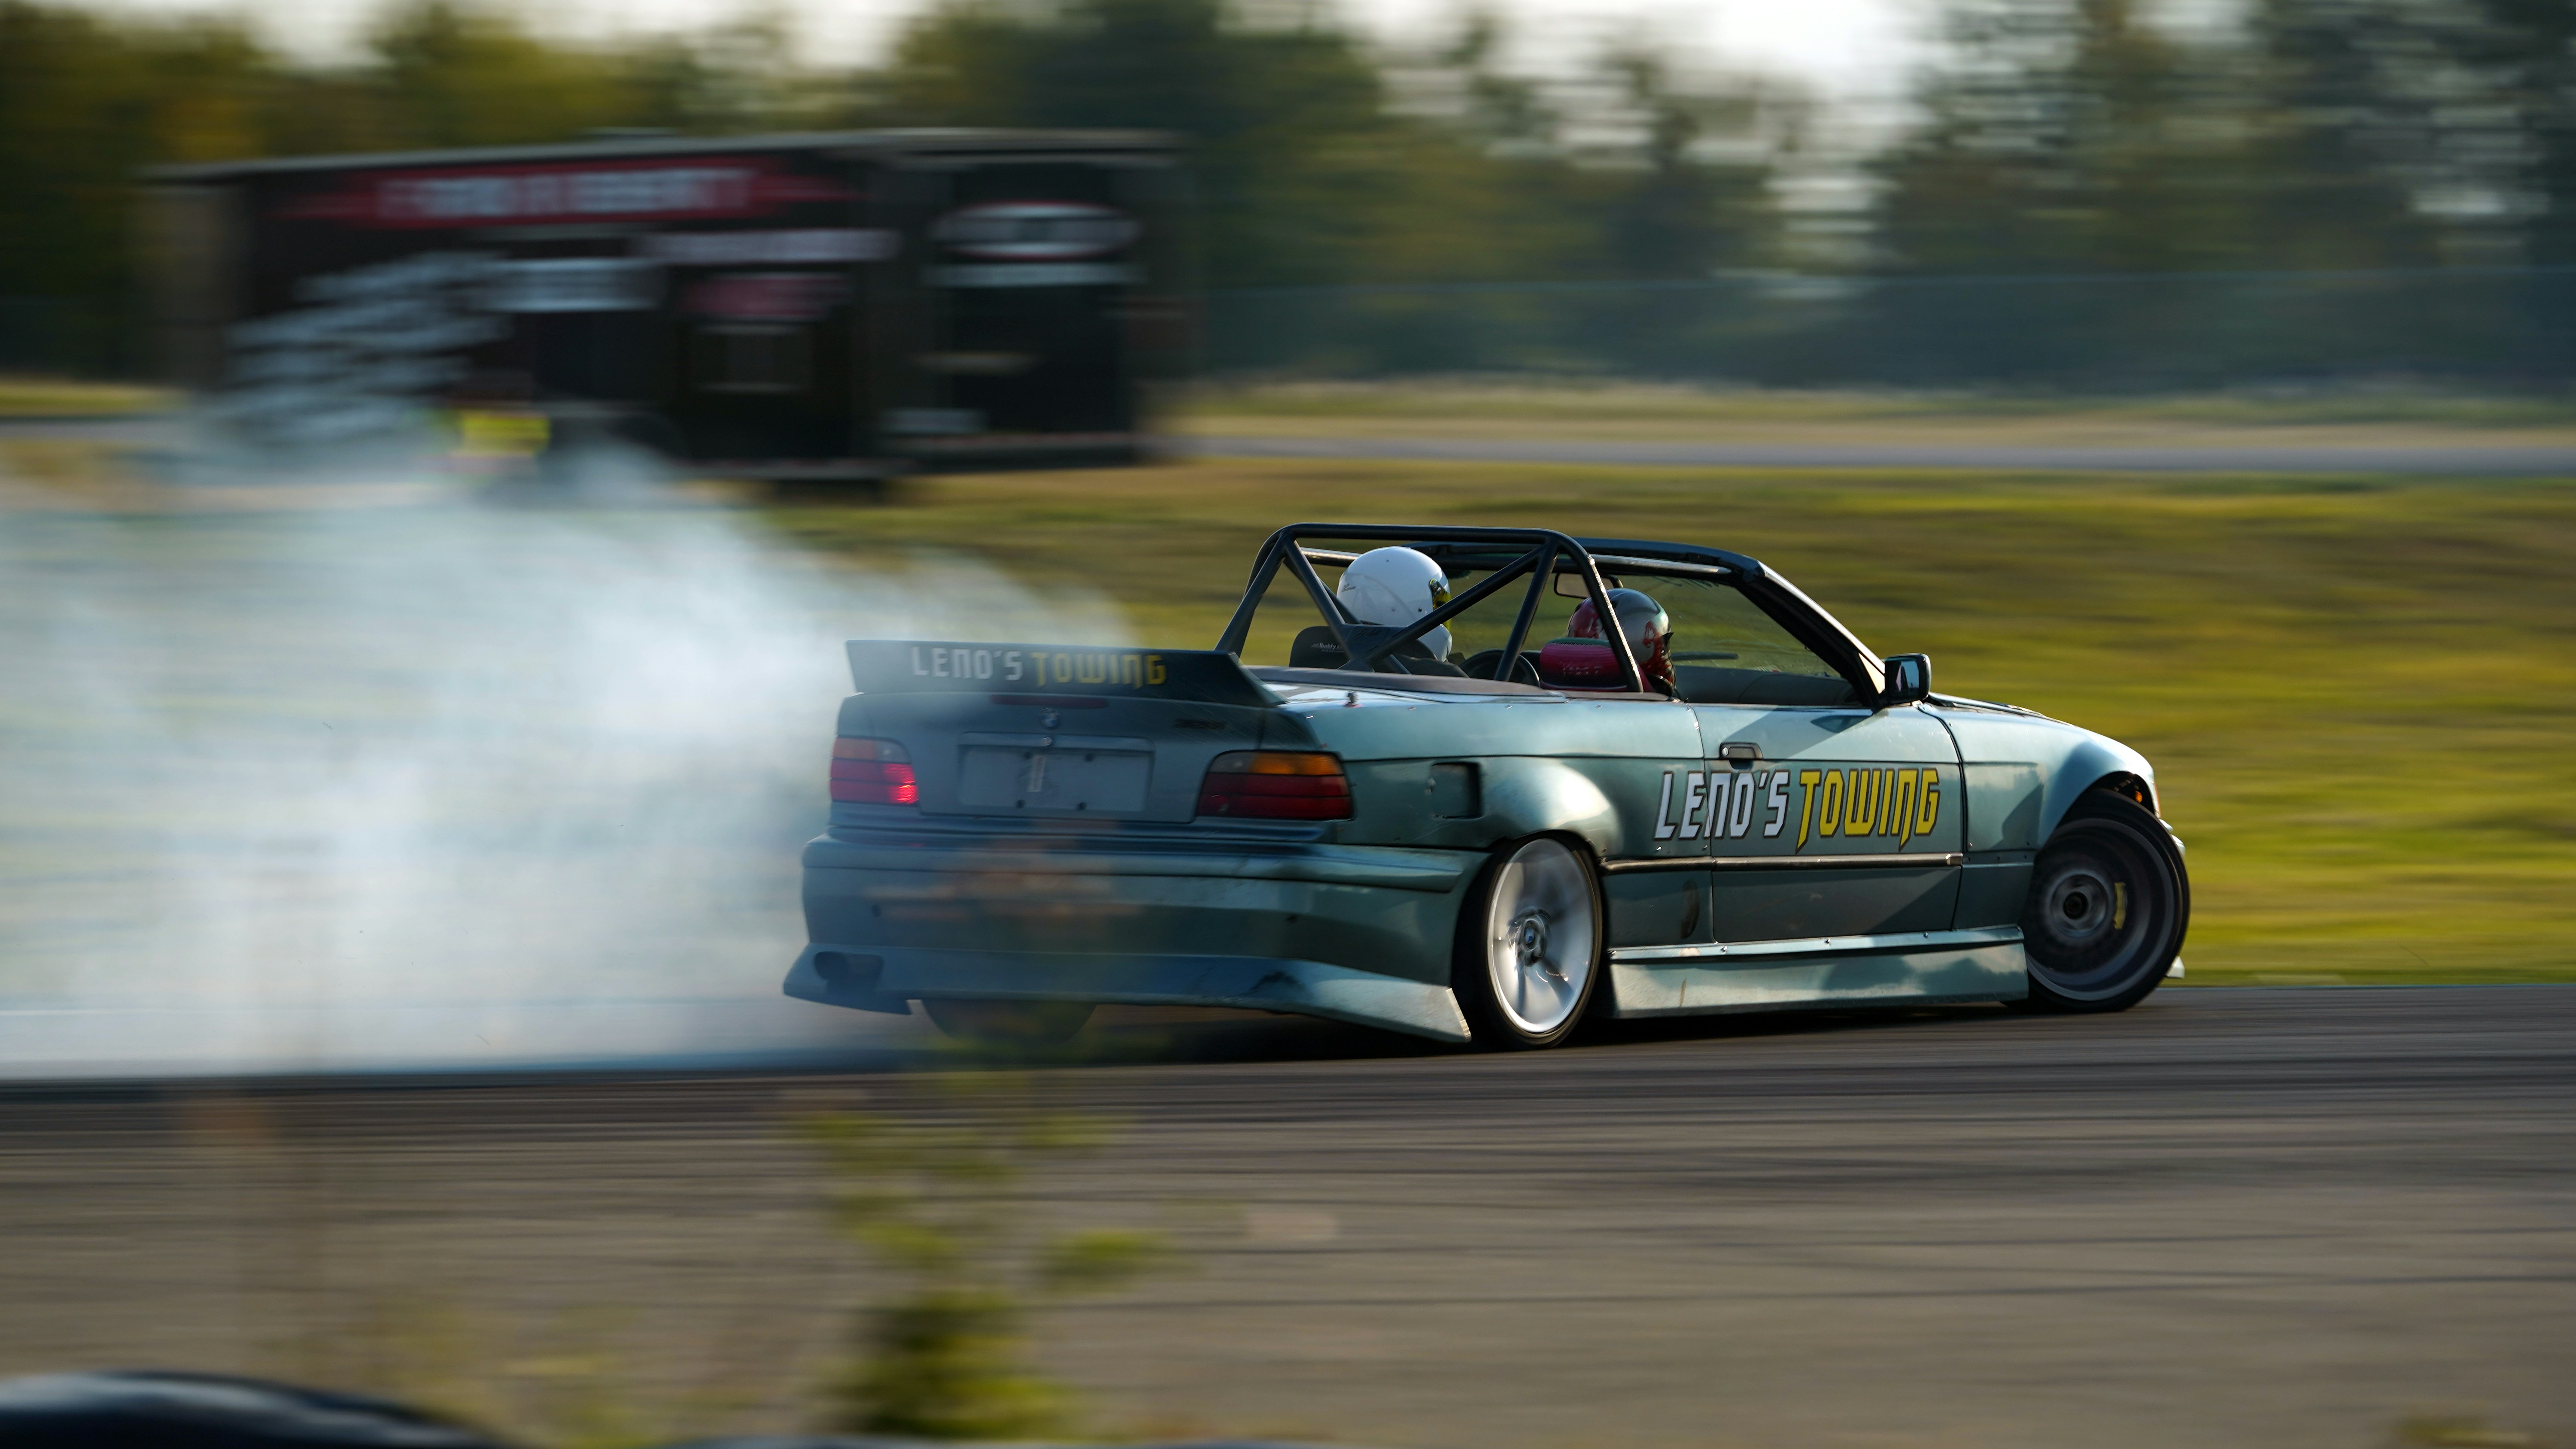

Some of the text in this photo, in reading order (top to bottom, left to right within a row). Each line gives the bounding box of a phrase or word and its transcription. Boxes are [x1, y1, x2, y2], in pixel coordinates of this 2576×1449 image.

[913, 646, 1166, 689] LENO'S TOWING
[1653, 767, 1940, 854] LENO'S TOWING
